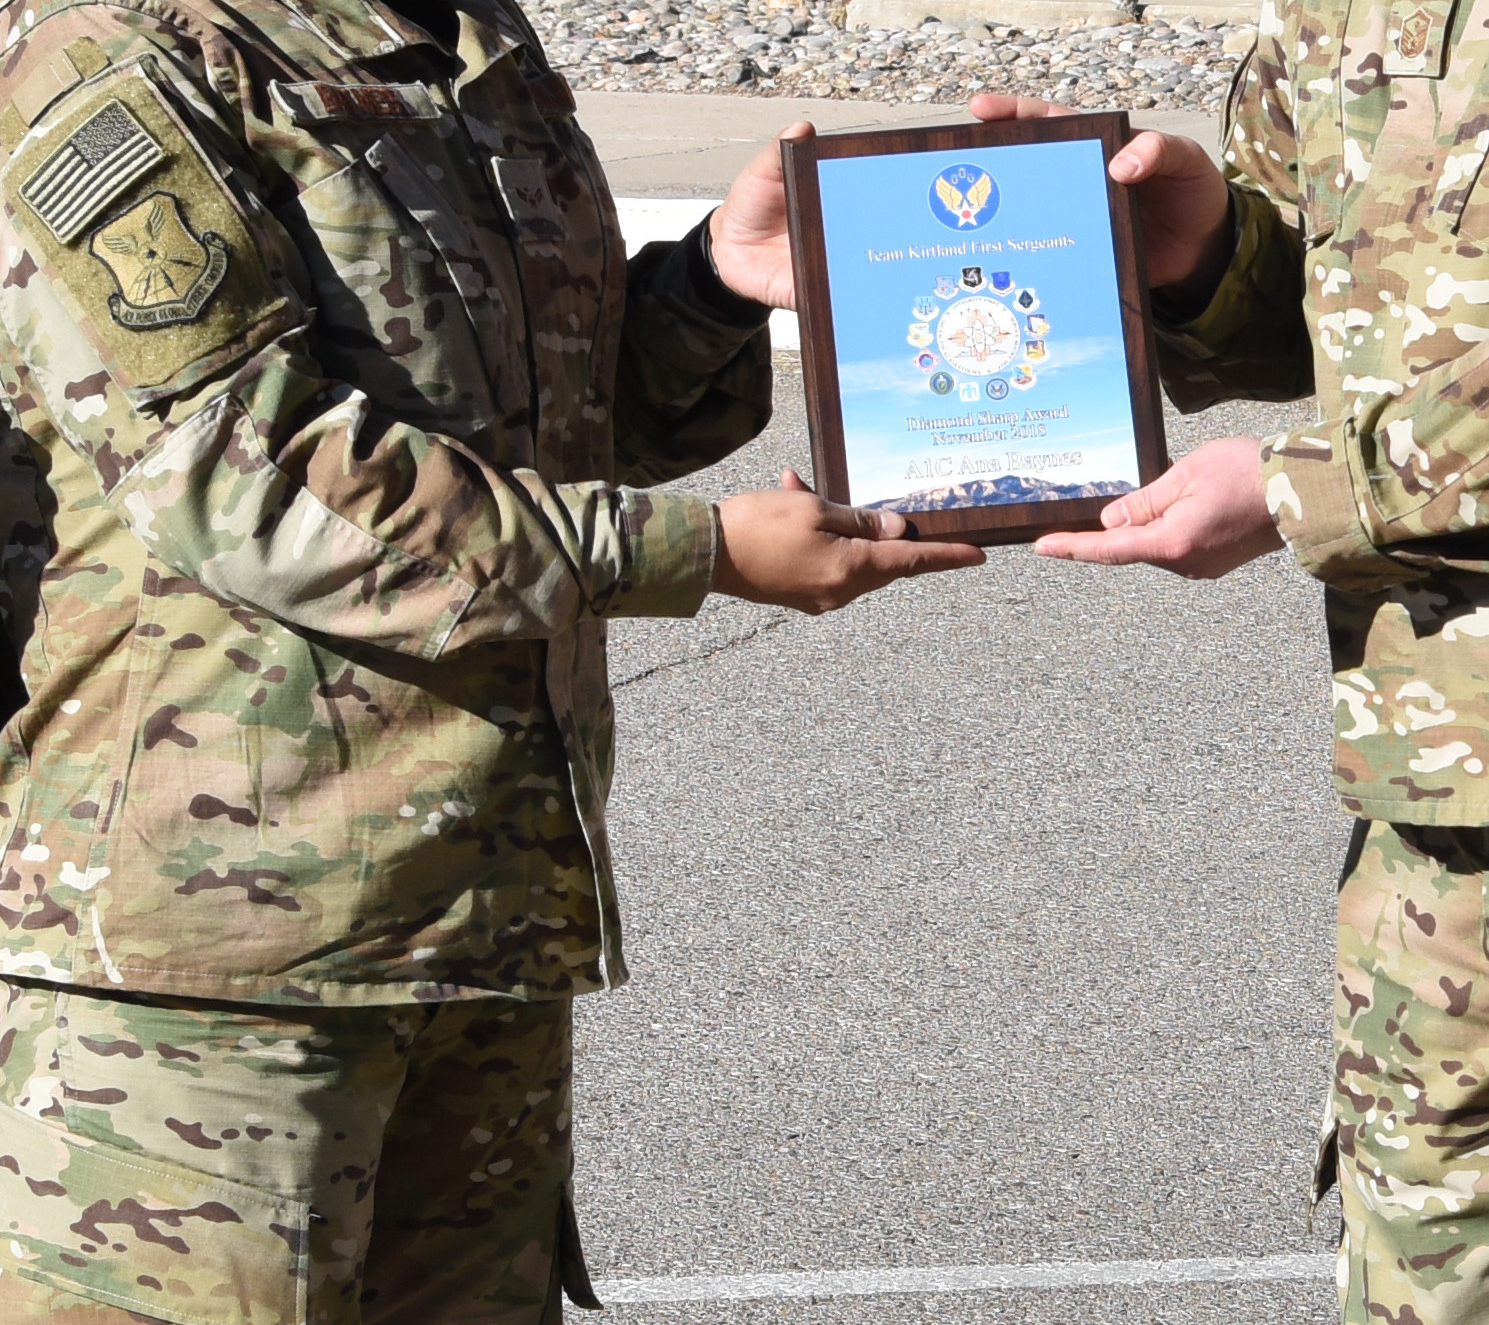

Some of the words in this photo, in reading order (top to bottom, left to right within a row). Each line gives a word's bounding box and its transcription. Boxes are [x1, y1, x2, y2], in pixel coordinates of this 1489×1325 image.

[865, 248, 904, 262] Team
[908, 242, 967, 259] Kirtland
[970, 240, 1003, 255] First
[1006, 235, 1076, 253] Sergeants
[906, 412, 974, 431] Diamond
[977, 410, 1019, 427] Sharp
[1021, 405, 1069, 422] Award
[931, 427, 1008, 446] November
[1011, 423, 1047, 439] 2018
[903, 456, 953, 479] A1C
[957, 455, 1002, 475] Ana
[1005, 450, 1083, 473] Baynes
